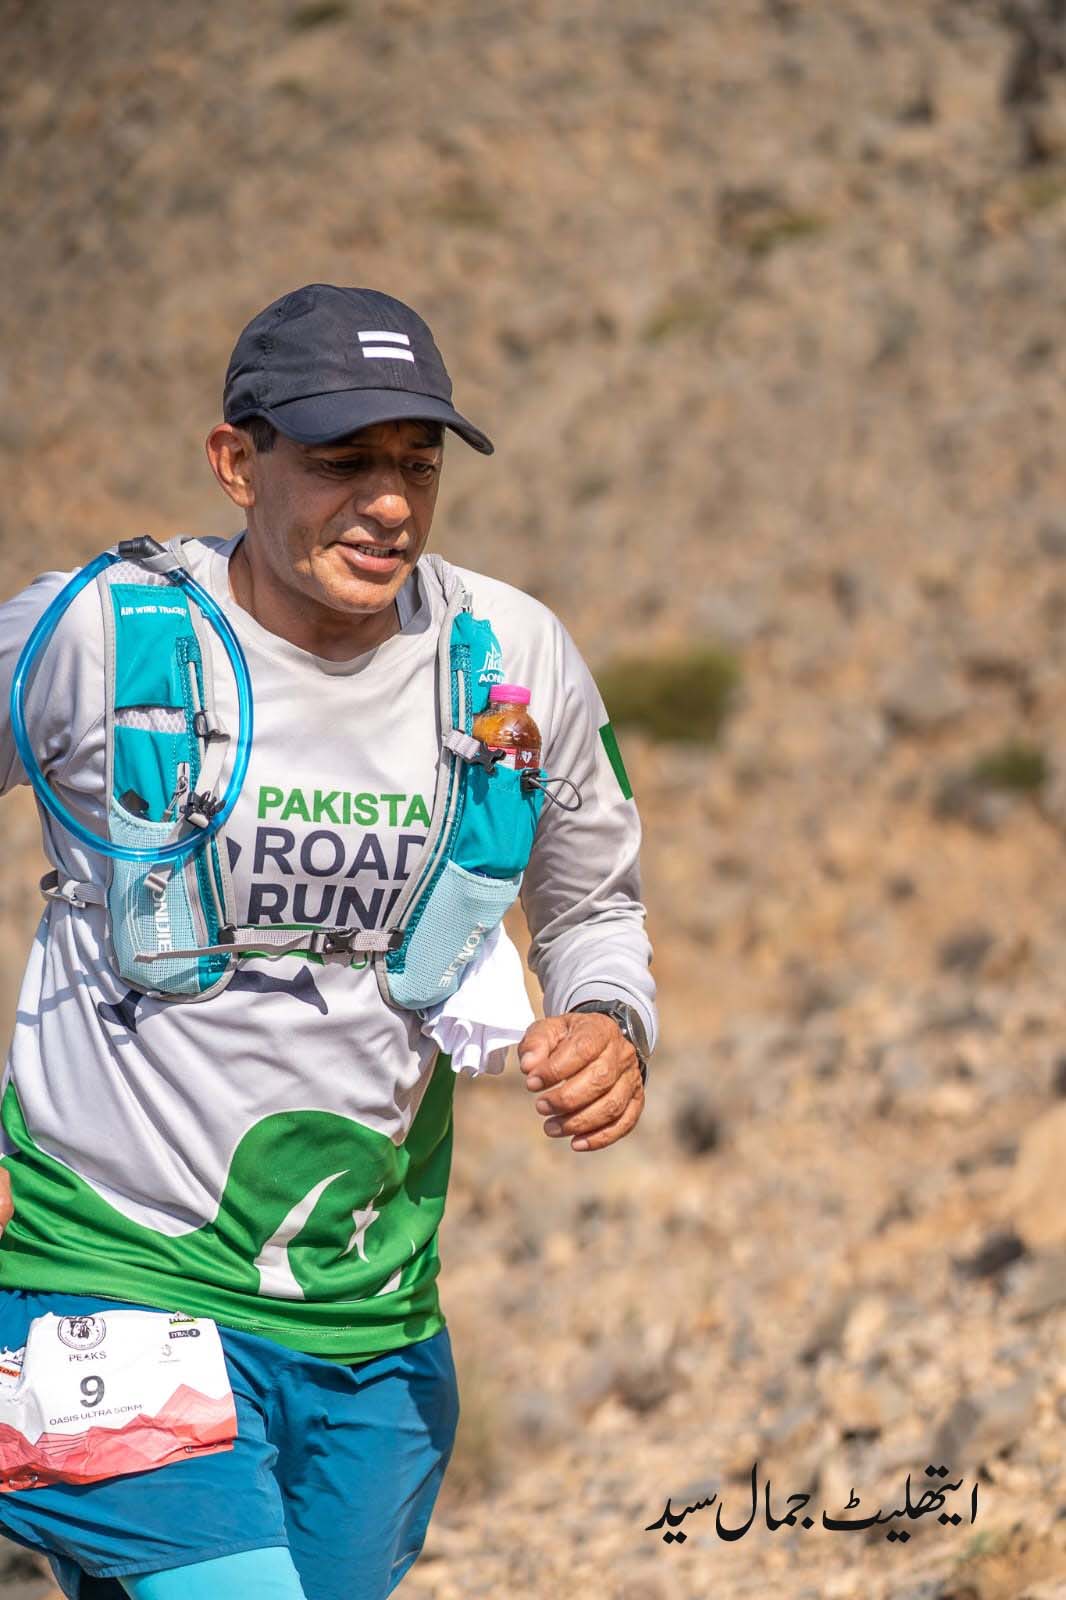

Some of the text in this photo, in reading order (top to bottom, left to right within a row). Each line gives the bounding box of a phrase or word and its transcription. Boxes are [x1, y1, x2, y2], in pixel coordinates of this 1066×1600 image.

[257, 785, 431, 828] PAKISTA
[253, 826, 427, 881] ROAD
[247, 883, 402, 930] RUN
[68, 1350, 107, 1363] PEAKS
[79, 1375, 106, 1408] 9
[49, 1412, 80, 1426] OASIS
[80, 1407, 113, 1421] ULTRA
